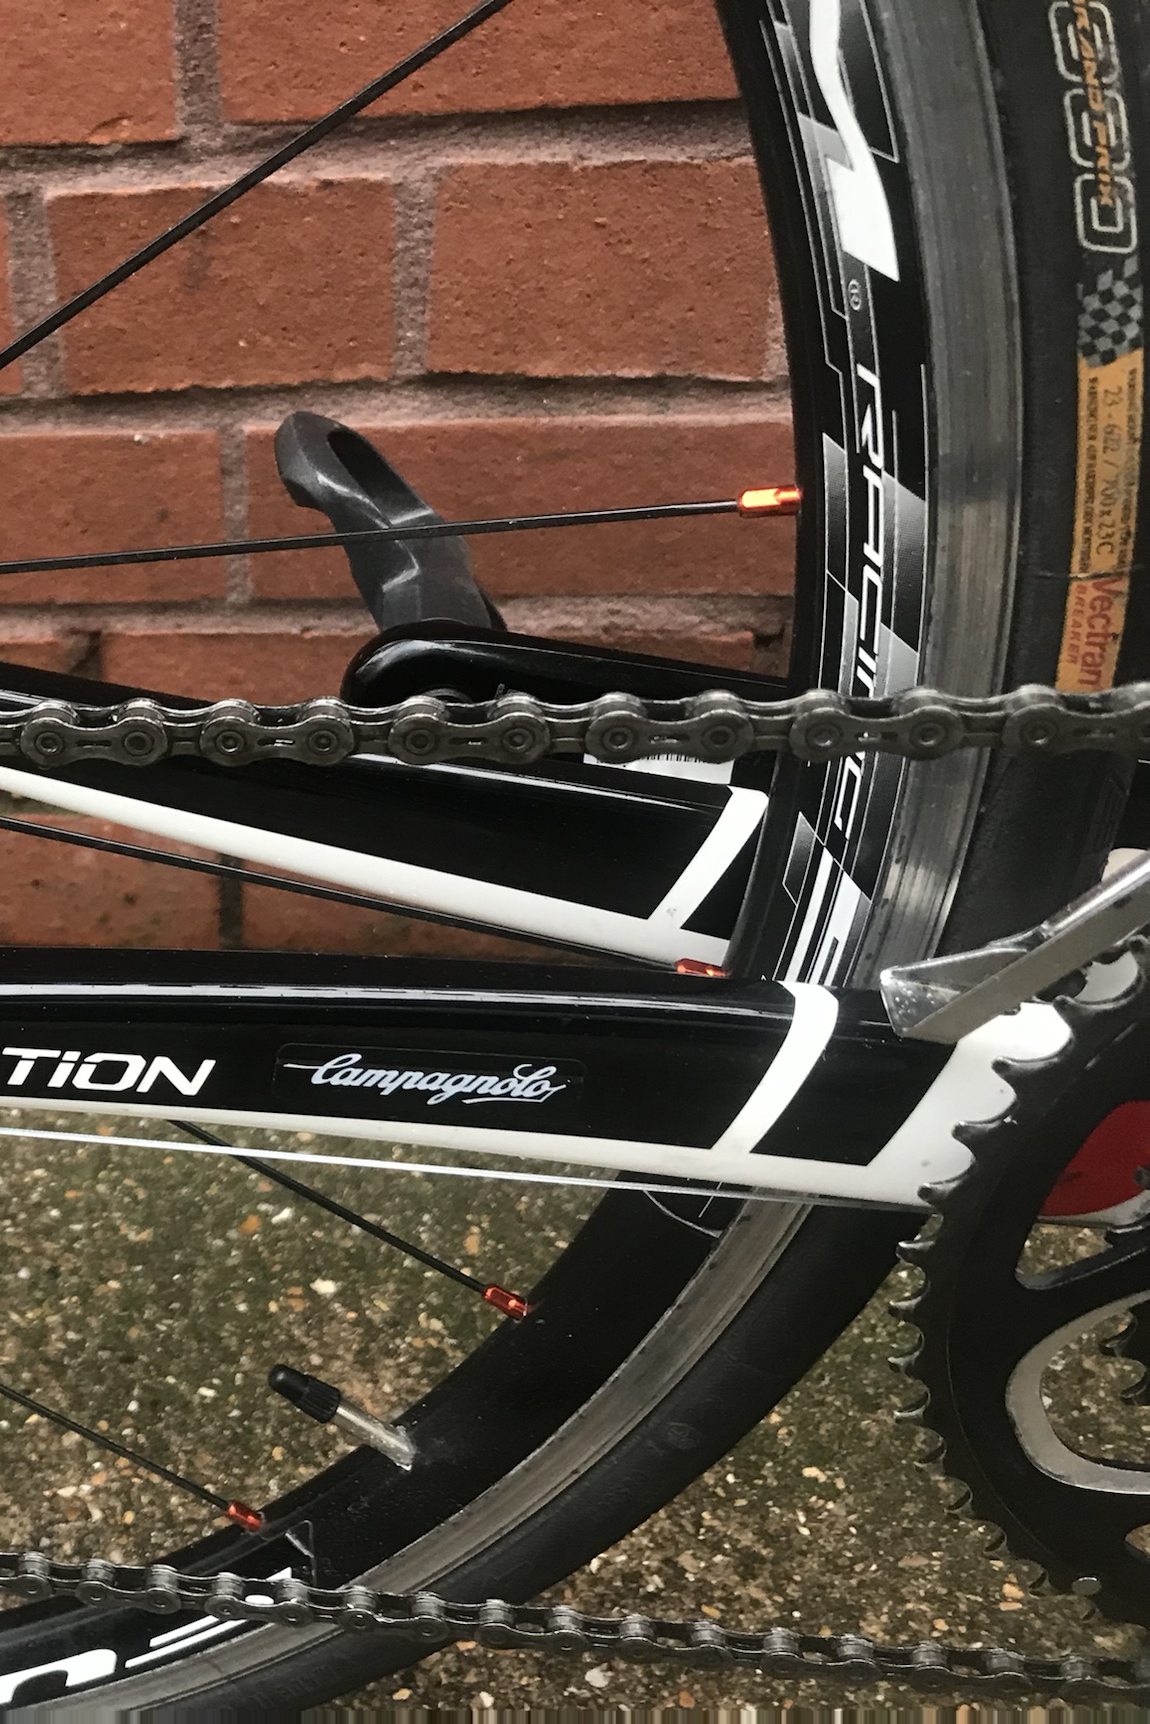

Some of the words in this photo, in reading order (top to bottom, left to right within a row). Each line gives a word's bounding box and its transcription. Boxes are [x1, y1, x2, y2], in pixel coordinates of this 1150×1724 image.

[1072, 0, 1103, 111] RAND
[1092, 120, 1114, 207] PRIX
[1066, 584, 1088, 665] BREAKER
[1077, 576, 1125, 686] Vectran
[283, 1053, 566, 1105] Campagnolo
